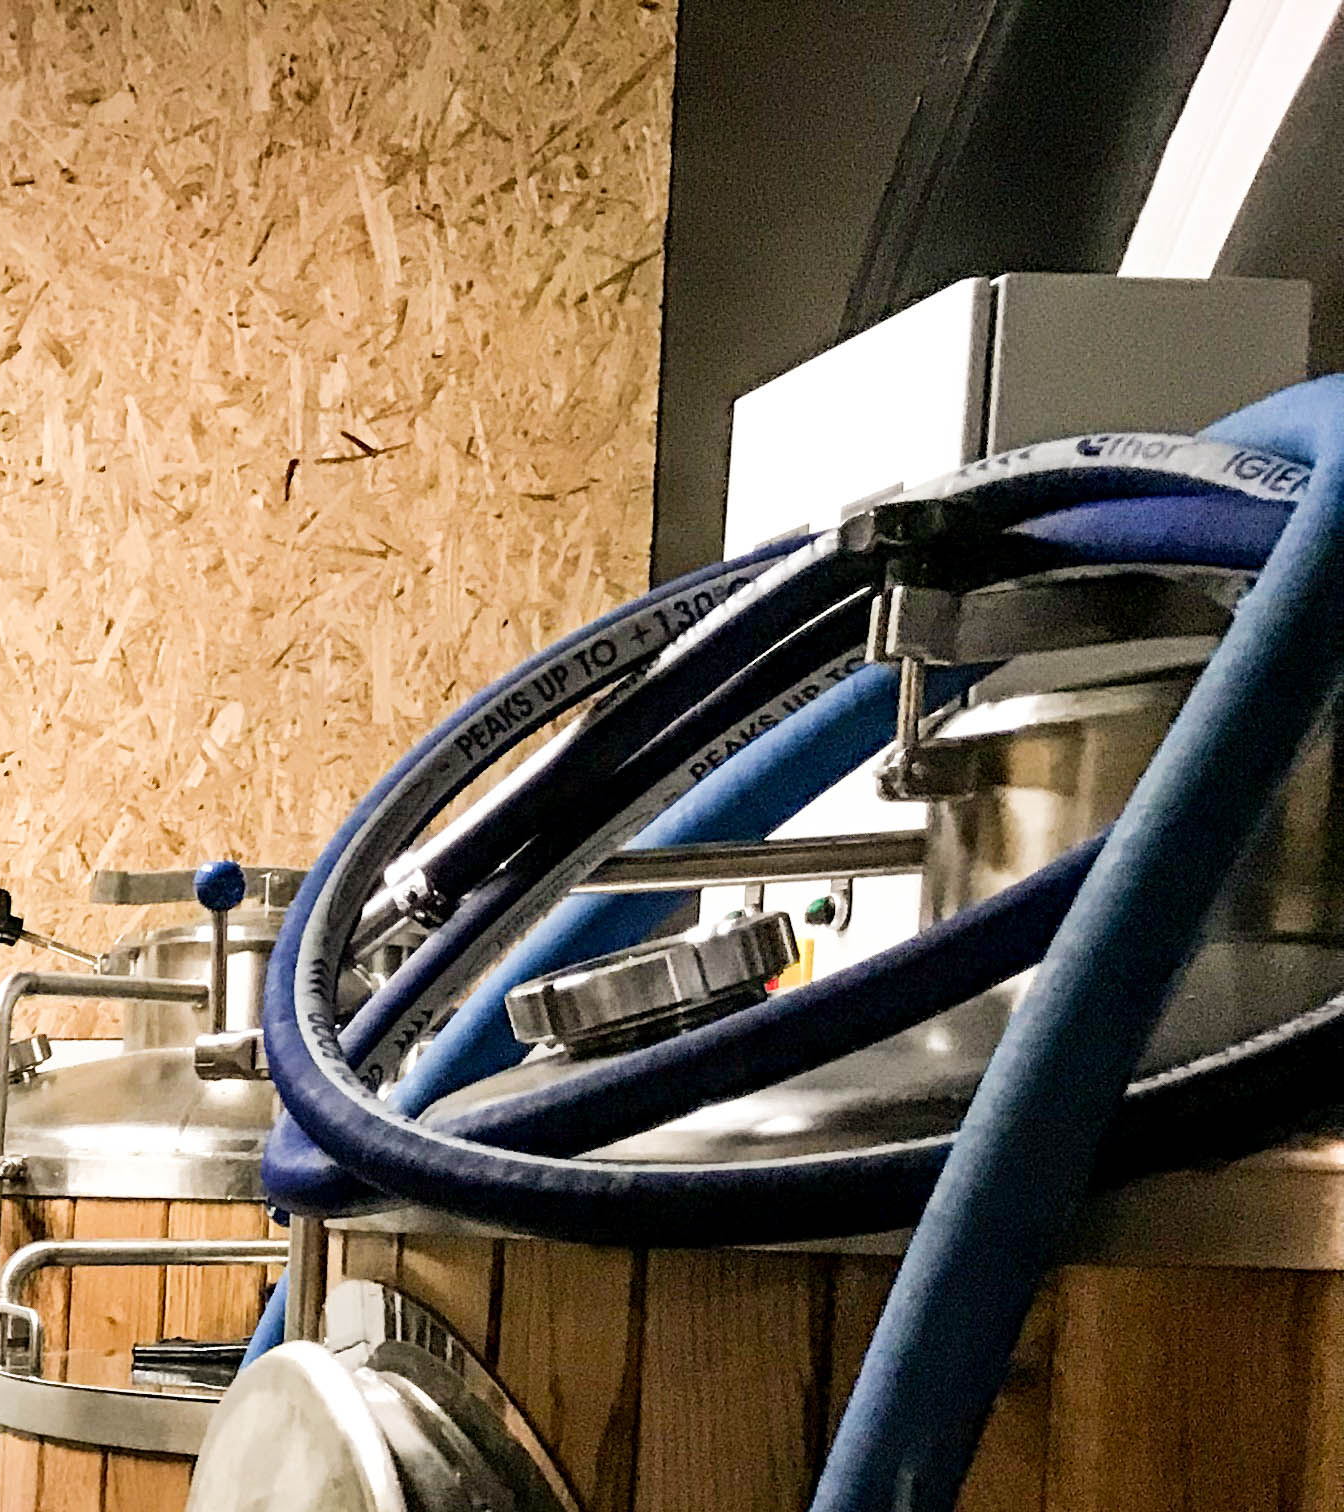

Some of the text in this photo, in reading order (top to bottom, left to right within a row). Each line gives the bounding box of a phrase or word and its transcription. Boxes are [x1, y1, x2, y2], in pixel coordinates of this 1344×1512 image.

[454, 689, 535, 761] PEAKS
[532, 663, 569, 702] UP
[573, 638, 618, 680] TO
